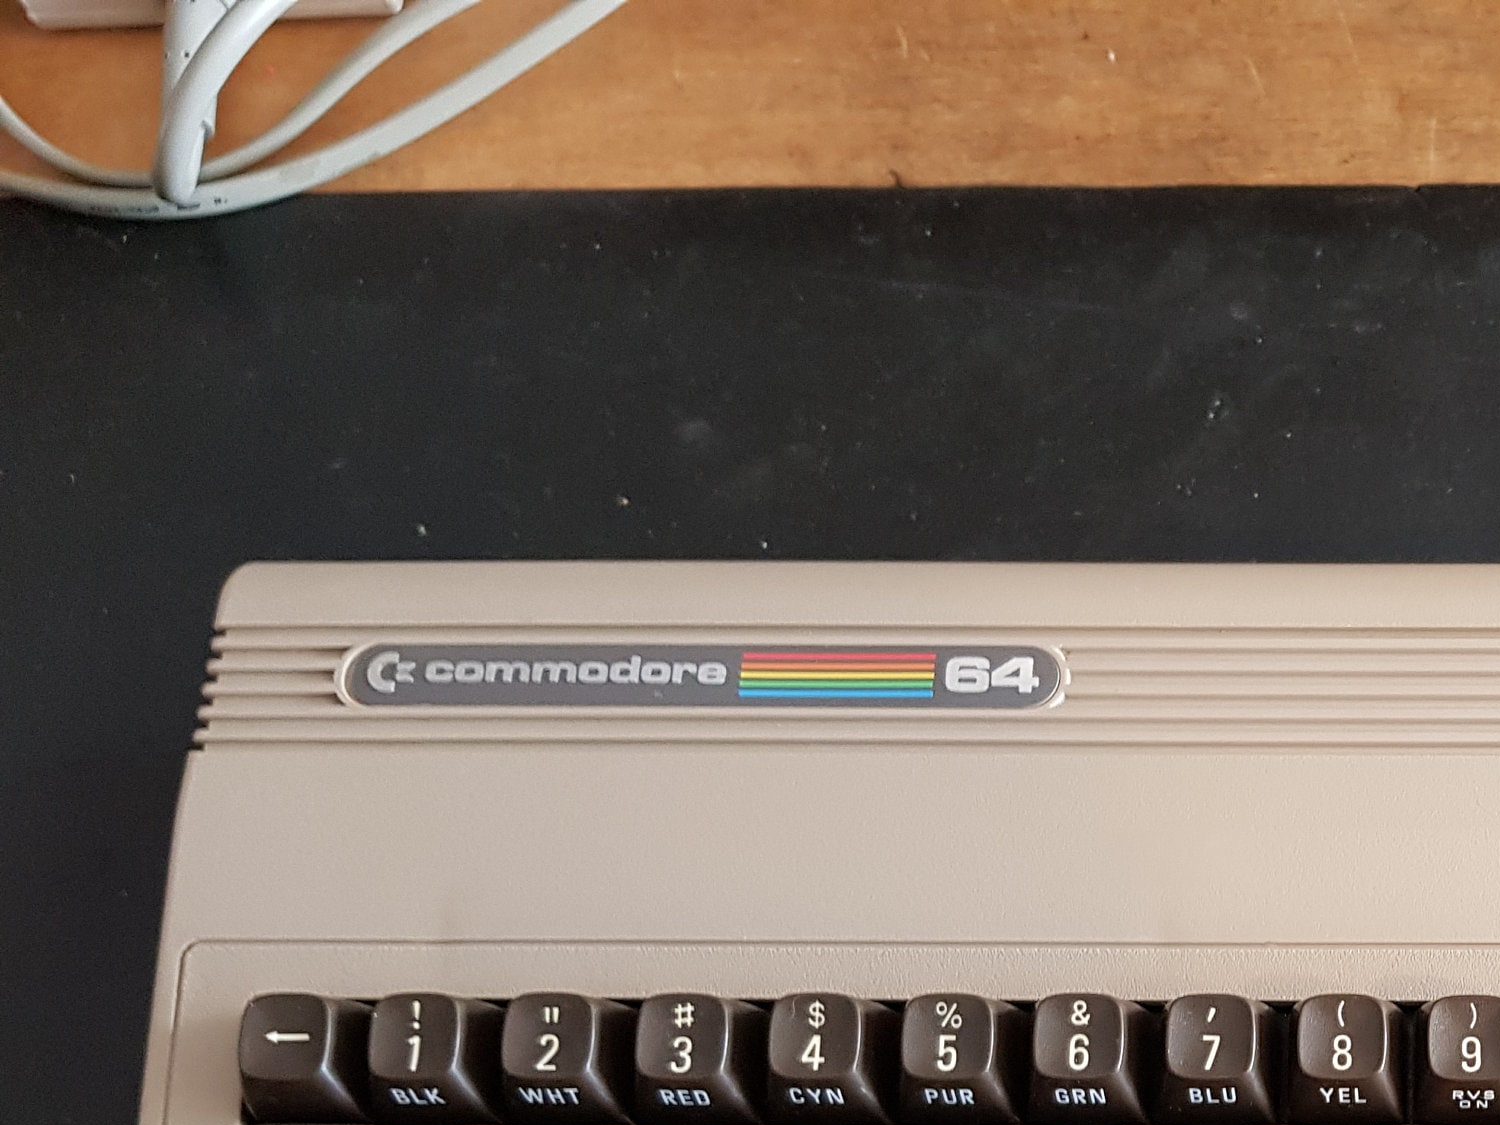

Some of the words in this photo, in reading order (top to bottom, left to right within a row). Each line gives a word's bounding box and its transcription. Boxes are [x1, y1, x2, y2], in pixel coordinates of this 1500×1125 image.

[425, 656, 727, 686] commodore
[945, 655, 1040, 694] 64
[412, 1000, 421, 1030] !
[674, 1002, 695, 1029] #
[808, 1000, 826, 1029] $
[935, 1001, 963, 1029] %
[1070, 1000, 1091, 1026] &
[1337, 1000, 1345, 1028] (
[1469, 1002, 1477, 1029] )
[407, 1035, 421, 1072] 1
[535, 1034, 559, 1071] 2
[670, 1036, 693, 1074] 3
[800, 1034, 825, 1071] 4
[936, 1034, 957, 1072] 5
[1068, 1033, 1090, 1071] 6
[1202, 1034, 1221, 1071] 7
[1332, 1034, 1353, 1071] 8
[1461, 1036, 1482, 1073] 9
[391, 1087, 445, 1105] BLK
[518, 1087, 579, 1105] WHT
[659, 1089, 711, 1106] RED
[789, 1087, 845, 1104] CYN
[924, 1088, 975, 1105] PUR
[1054, 1088, 1106, 1104] GRN
[1188, 1087, 1237, 1104] BLU
[1319, 1087, 1367, 1104] YEL
[1452, 1089, 1495, 1100] RVS
[1459, 1100, 1488, 1109] ON
